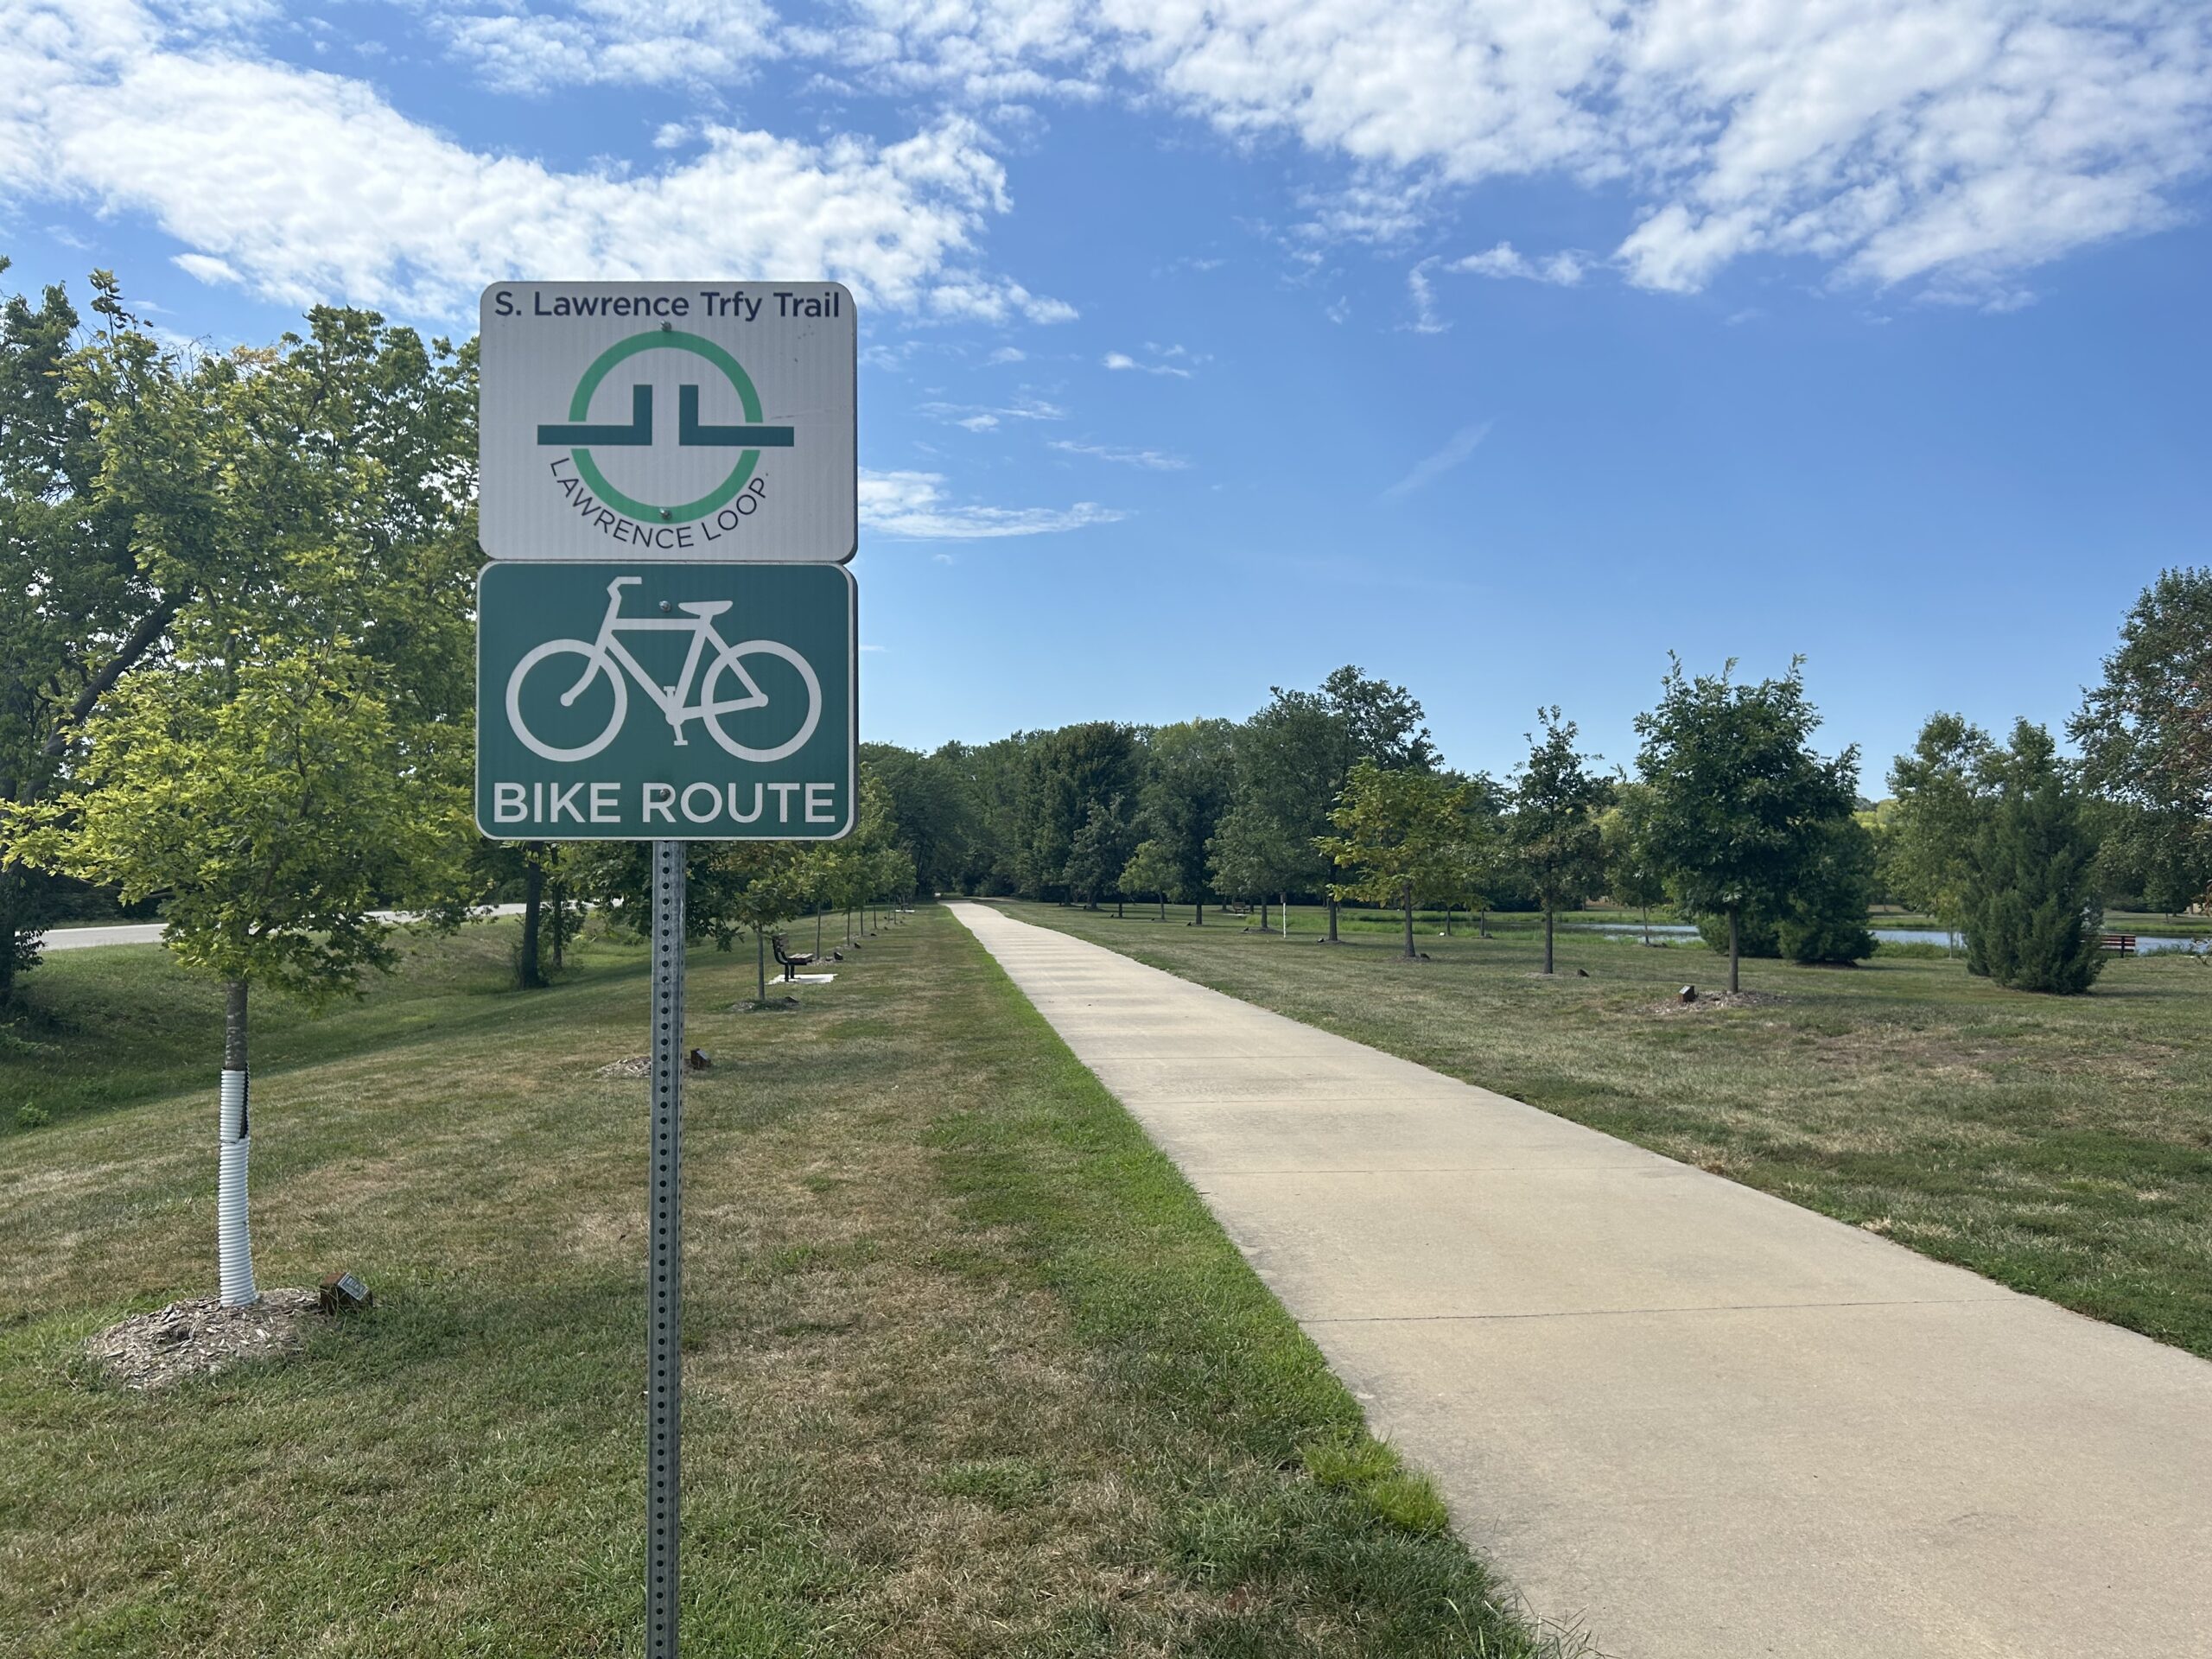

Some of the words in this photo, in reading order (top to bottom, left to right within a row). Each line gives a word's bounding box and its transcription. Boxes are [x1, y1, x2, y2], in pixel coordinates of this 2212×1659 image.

[494, 291, 522, 316] S.
[534, 292, 690, 317] Lawrence
[701, 292, 763, 321] Trfy
[774, 292, 839, 317] Trail
[550, 458, 695, 549] LAWRENCE
[702, 477, 767, 542] LOOP
[493, 783, 621, 823] BIKE
[642, 782, 836, 823] ROUTE
